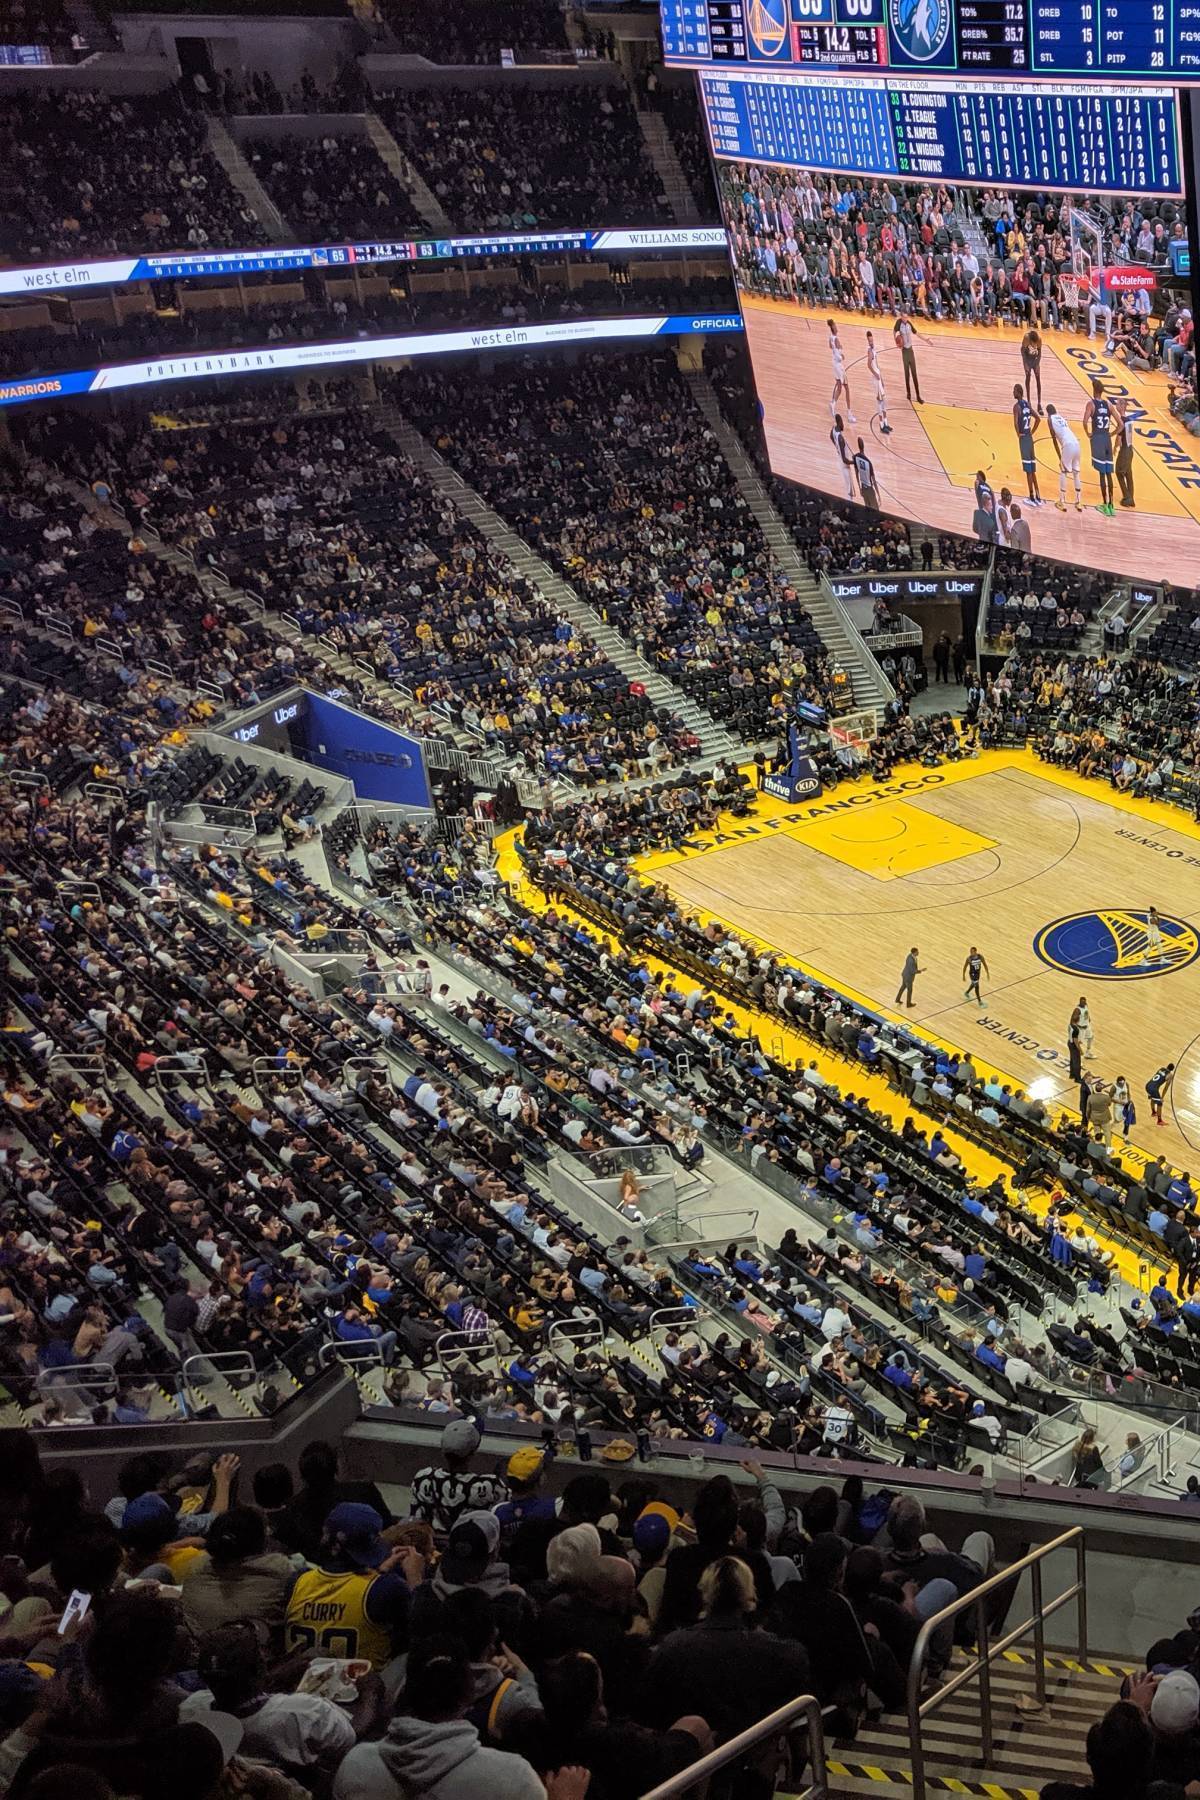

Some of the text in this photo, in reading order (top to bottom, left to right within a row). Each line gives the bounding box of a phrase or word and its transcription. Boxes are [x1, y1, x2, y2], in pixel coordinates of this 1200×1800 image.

[961, 5, 1023, 20] TO% 17.2
[1038, 6, 1092, 20] OREB 10
[1107, 6, 1164, 20] TO 12
[1180, 8, 1200, 18] 3P%
[824, 28, 850, 50] 14.2
[1005, 28, 1024, 42] 35.7
[1040, 28, 1092, 43] DREB 15
[1107, 29, 1164, 43] POT 11
[831, 54, 856, 63] QUARTER
[963, 50, 1024, 64] FT RATE 25
[1040, 53, 1054, 62] STL
[1107, 52, 1164, 66] PITP 28
[1181, 56, 1200, 65] FT%
[629, 232, 689, 244] WILLIAMS
[332, 250, 344, 262] 65
[421, 245, 432, 255] 63
[24, 268, 90, 287] west elm
[692, 318, 735, 330] OFFICIAL
[471, 330, 528, 346] west elm
[0, 380, 62, 399] WARRIORS
[832, 581, 975, 596] Uber Uber Uber Uber
[1135, 592, 1153, 601] Uber
[275, 704, 297, 725] Uber
[765, 778, 790, 796] thrive
[798, 779, 815, 791] KIA
[764, 774, 946, 829] FRANCISCO
[1115, 829, 1168, 852] CENTER
[976, 1016, 1040, 1050] CENTER
[303, 1602, 347, 1621] CURRY
